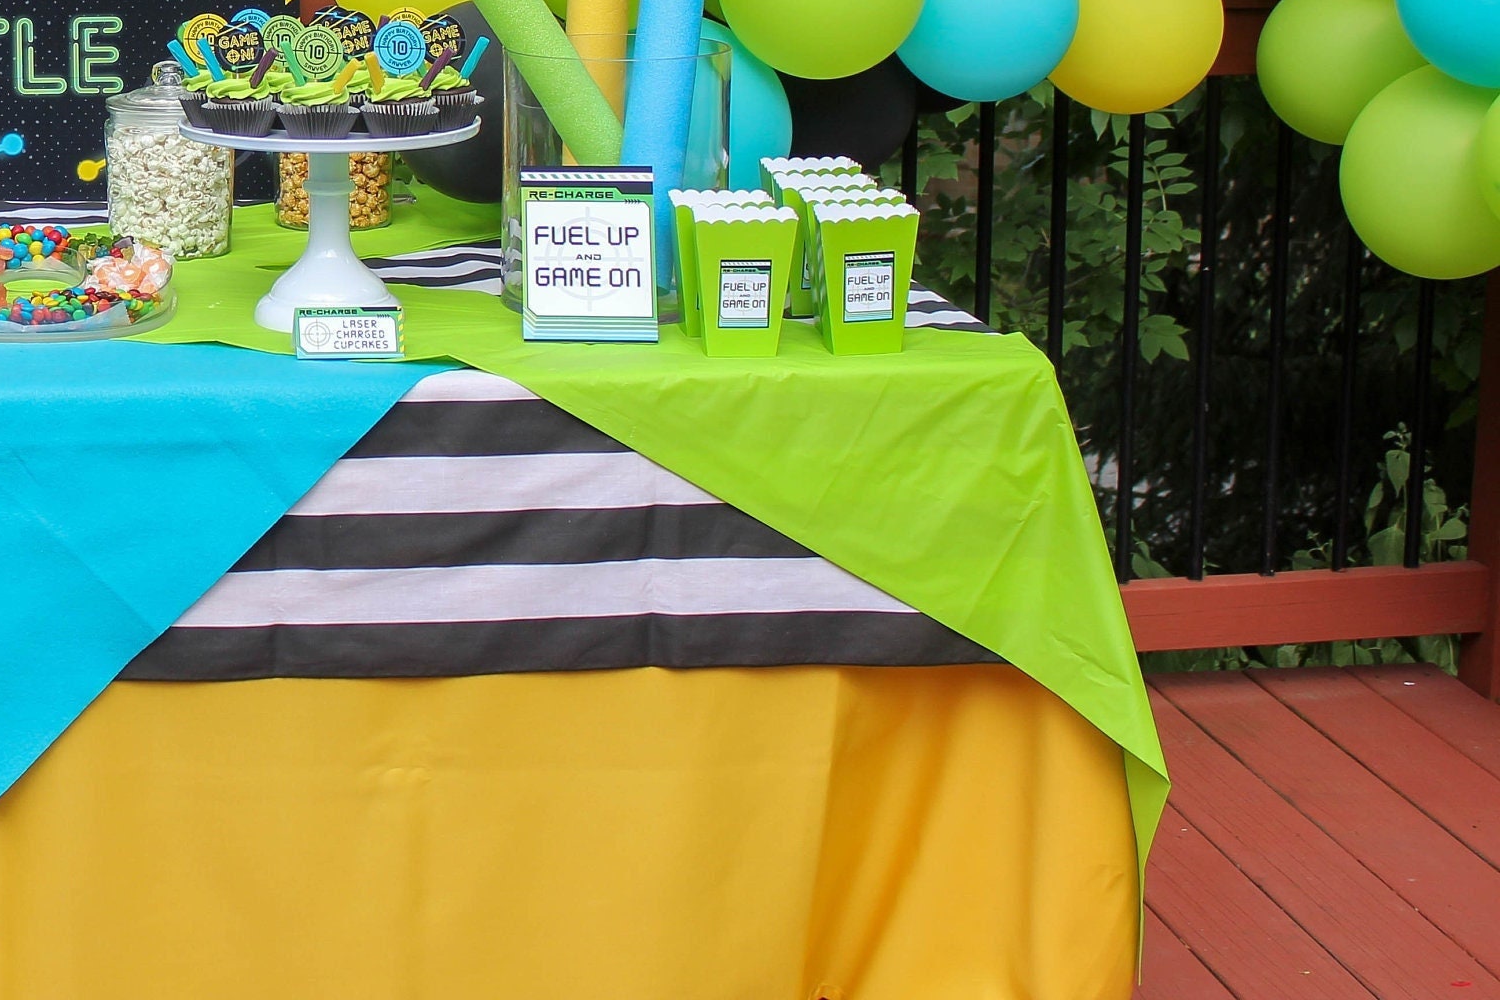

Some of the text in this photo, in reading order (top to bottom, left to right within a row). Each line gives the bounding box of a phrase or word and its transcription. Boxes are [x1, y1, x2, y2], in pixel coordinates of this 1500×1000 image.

[191, 22, 204, 38] HAPPY
[332, 20, 372, 40] GAME
[421, 24, 461, 44] GAME
[218, 31, 260, 50] GAME
[298, 32, 335, 52] HAPPY BIRTHDAY
[381, 27, 419, 47] HAPPY BIRTHDAY
[309, 44, 325, 60] 10
[391, 40, 408, 56] 10
[225, 47, 256, 64] ON!
[303, 62, 328, 72] SAWYER
[387, 58, 412, 67] SAWYER
[529, 190, 614, 201] RE-CHARGE
[534, 225, 640, 246] FUEL UP
[575, 253, 602, 261] AND
[535, 266, 641, 288] GAME ON
[847, 274, 890, 286] FUEL UP
[722, 282, 767, 292] FUEL UP
[847, 291, 890, 303] GAME ON
[722, 299, 766, 309] GAME ON
[299, 308, 358, 317] RE-CHARGE
[342, 319, 377, 329] LASER
[336, 329, 385, 339] CHARGED
[333, 340, 389, 350] CUPCAKES
